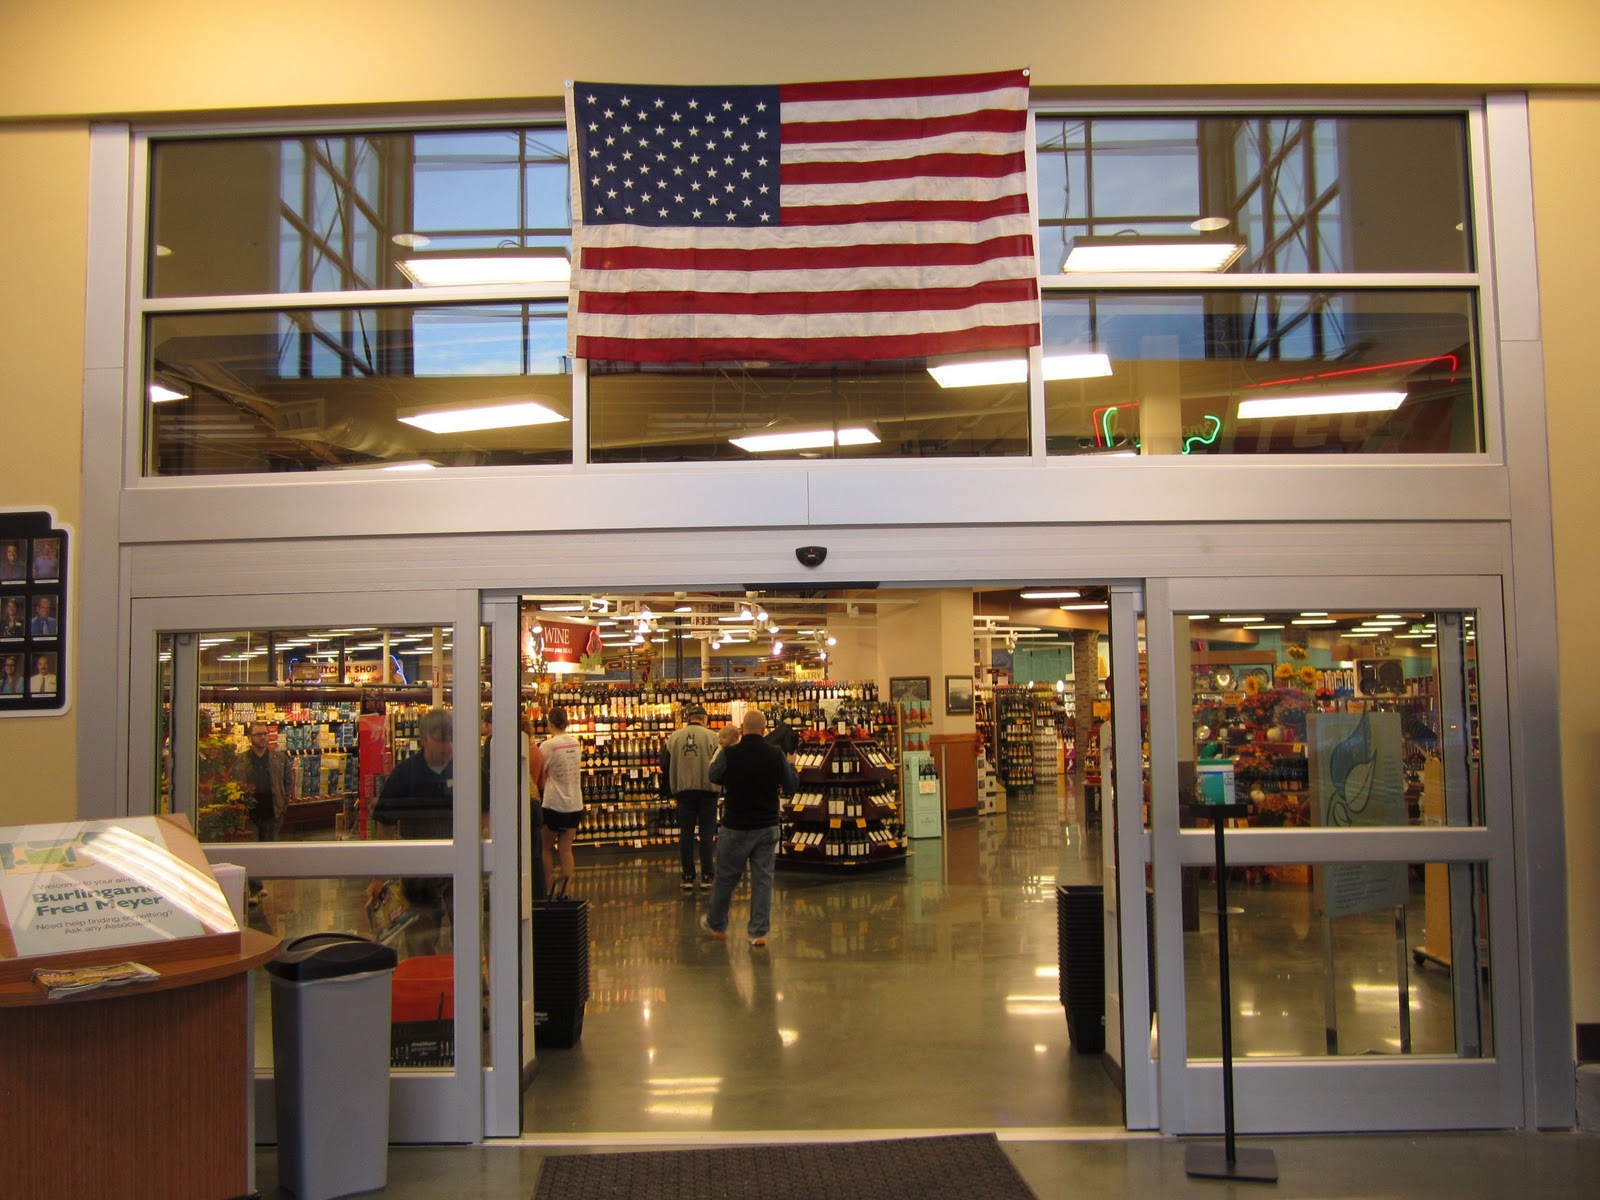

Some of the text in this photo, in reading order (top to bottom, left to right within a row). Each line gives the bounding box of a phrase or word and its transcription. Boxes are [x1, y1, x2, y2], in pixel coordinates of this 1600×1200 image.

[544, 626, 570, 645] WINE
[354, 665, 378, 674] SHOP
[36, 895, 163, 916] Fred Meyer
[35, 921, 63, 930] Need
[65, 919, 86, 927] help
[87, 915, 120, 924] finding
[64, 926, 83, 934] Ask
